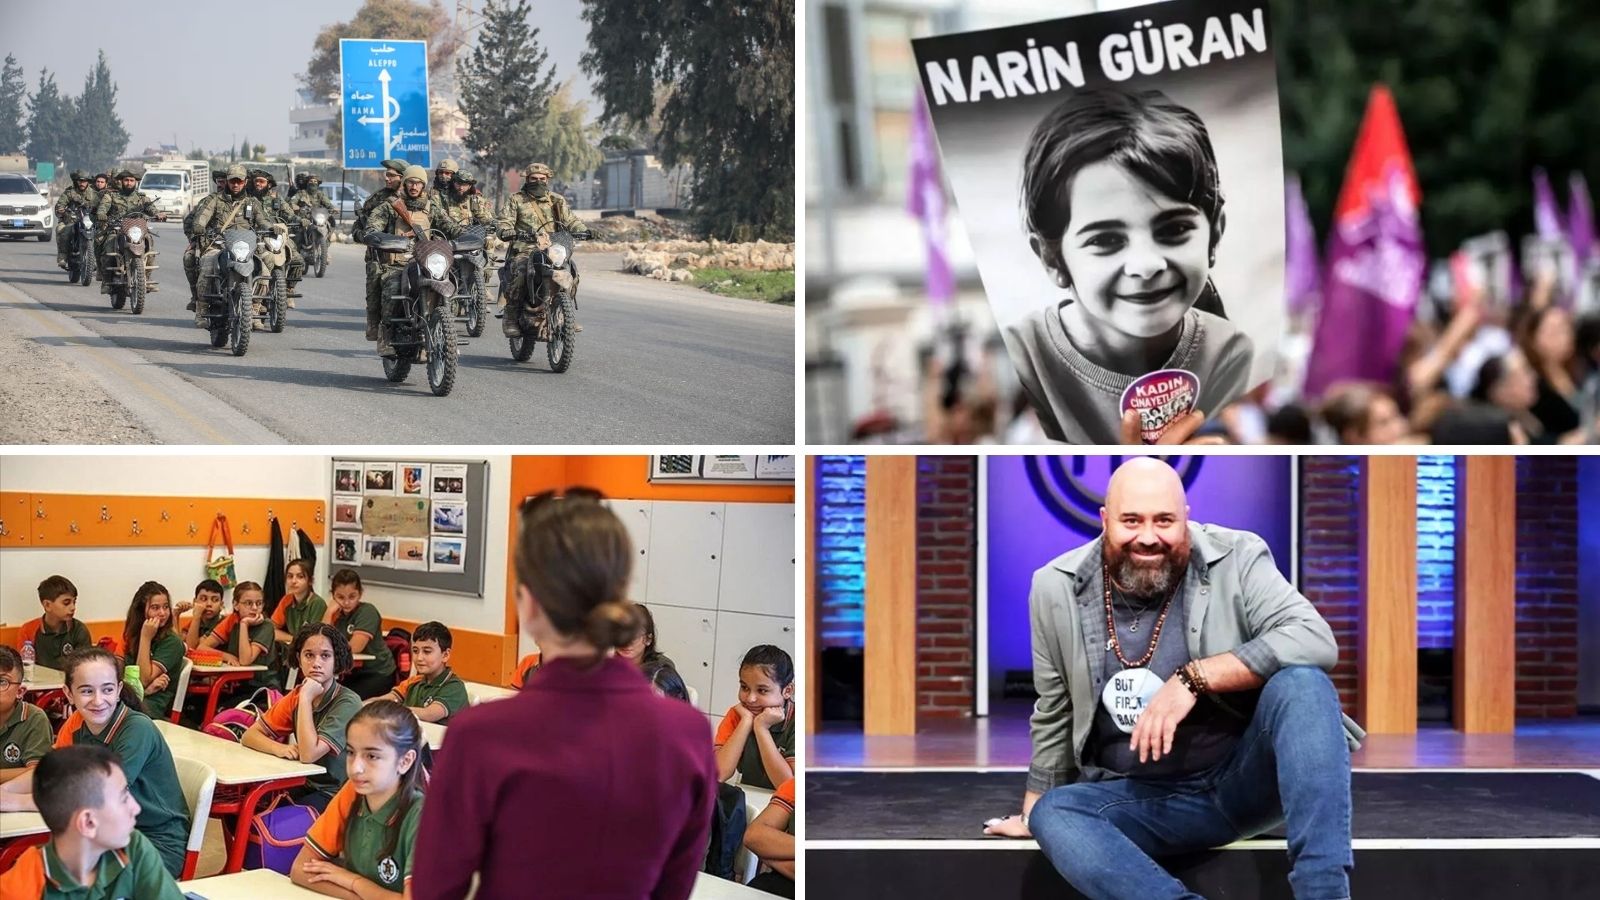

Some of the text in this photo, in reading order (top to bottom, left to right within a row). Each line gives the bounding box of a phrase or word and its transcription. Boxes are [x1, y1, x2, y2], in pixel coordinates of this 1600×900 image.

[370, 43, 396, 56] حلب
[368, 59, 397, 68] ALEPPO
[924, 8, 1267, 106] NARİN GÜRAN
[351, 106, 375, 115] HAMA
[368, 151, 377, 160] m
[1135, 375, 1184, 398] KADIN
[1115, 678, 1134, 691] BUT
